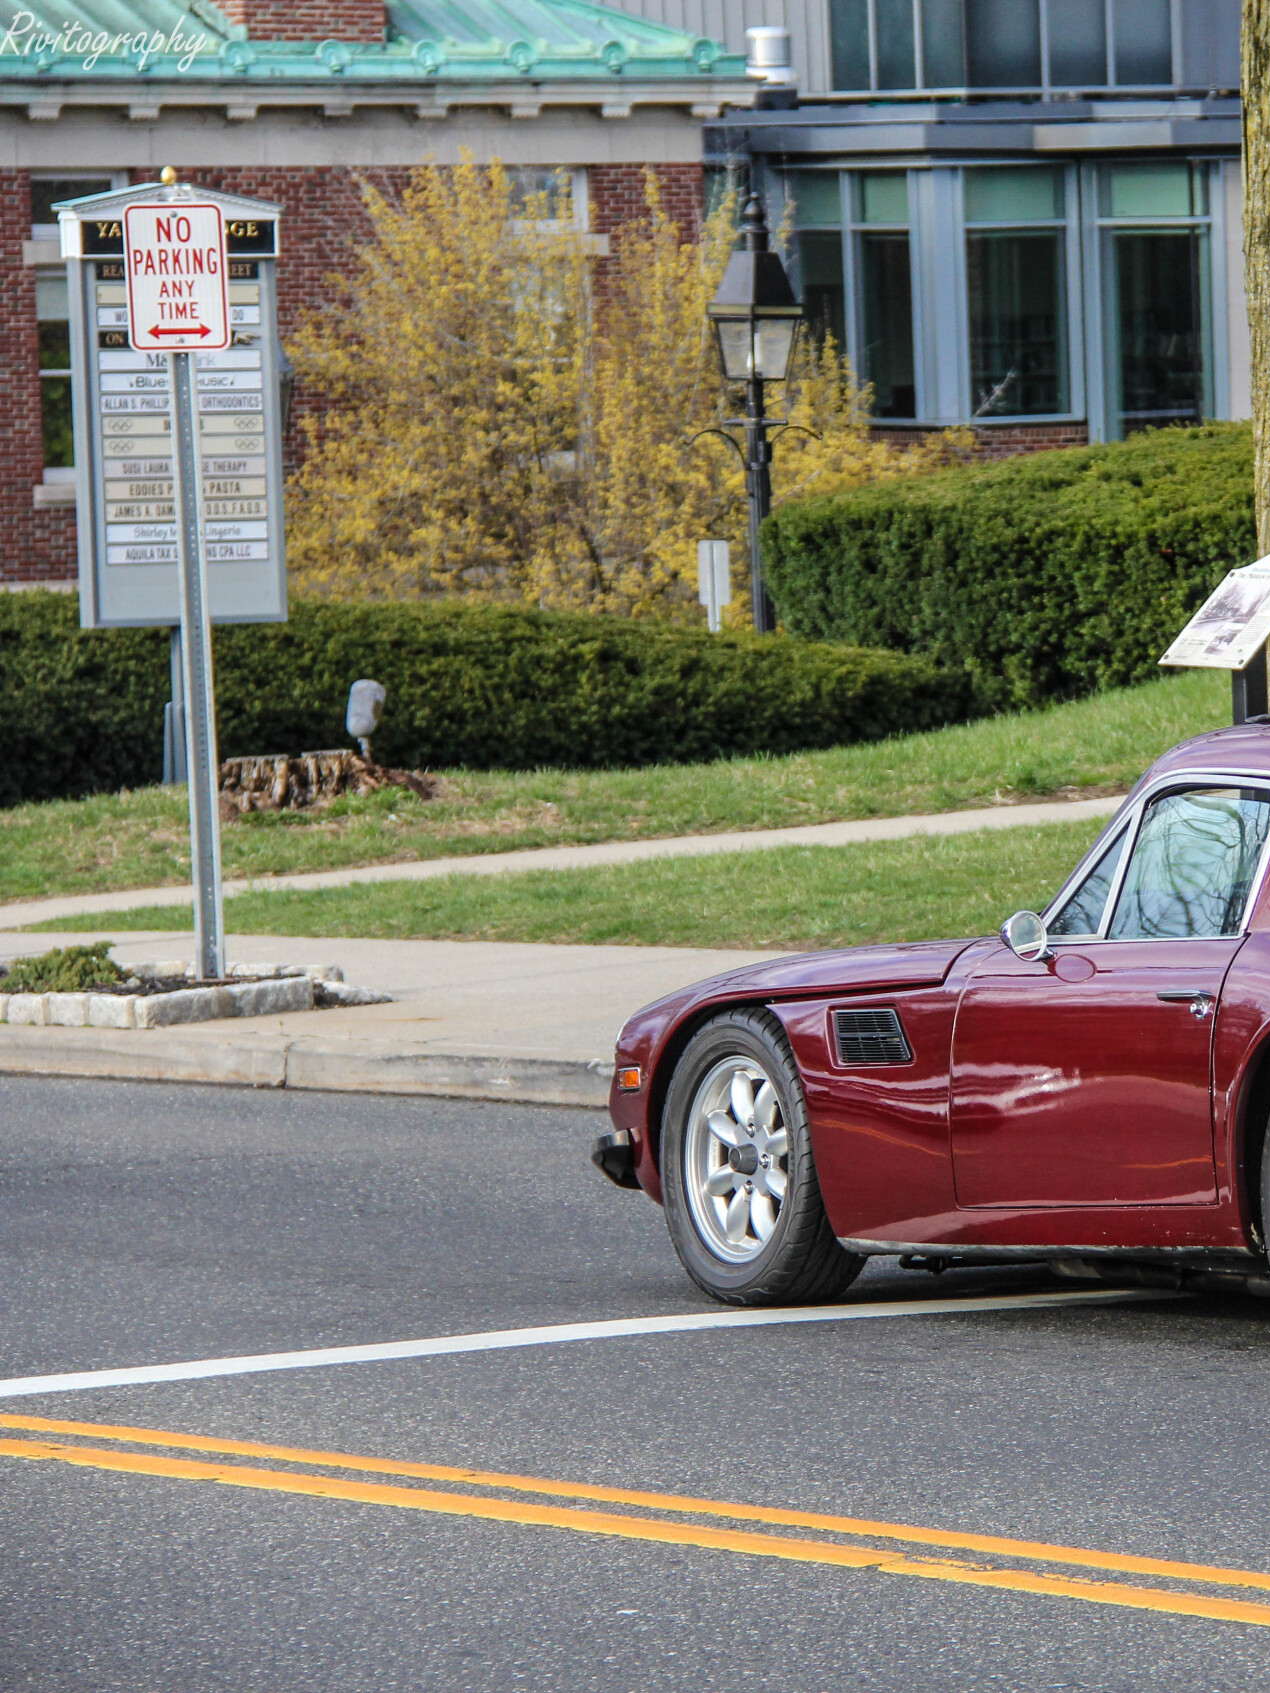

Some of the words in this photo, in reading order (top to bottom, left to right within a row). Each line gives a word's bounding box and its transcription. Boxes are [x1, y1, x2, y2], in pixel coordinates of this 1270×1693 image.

[156, 216, 191, 243] NO
[133, 248, 218, 276] PARKING
[159, 280, 195, 298] ANY
[158, 302, 199, 320] TIME
[209, 482, 241, 494] PASTA
